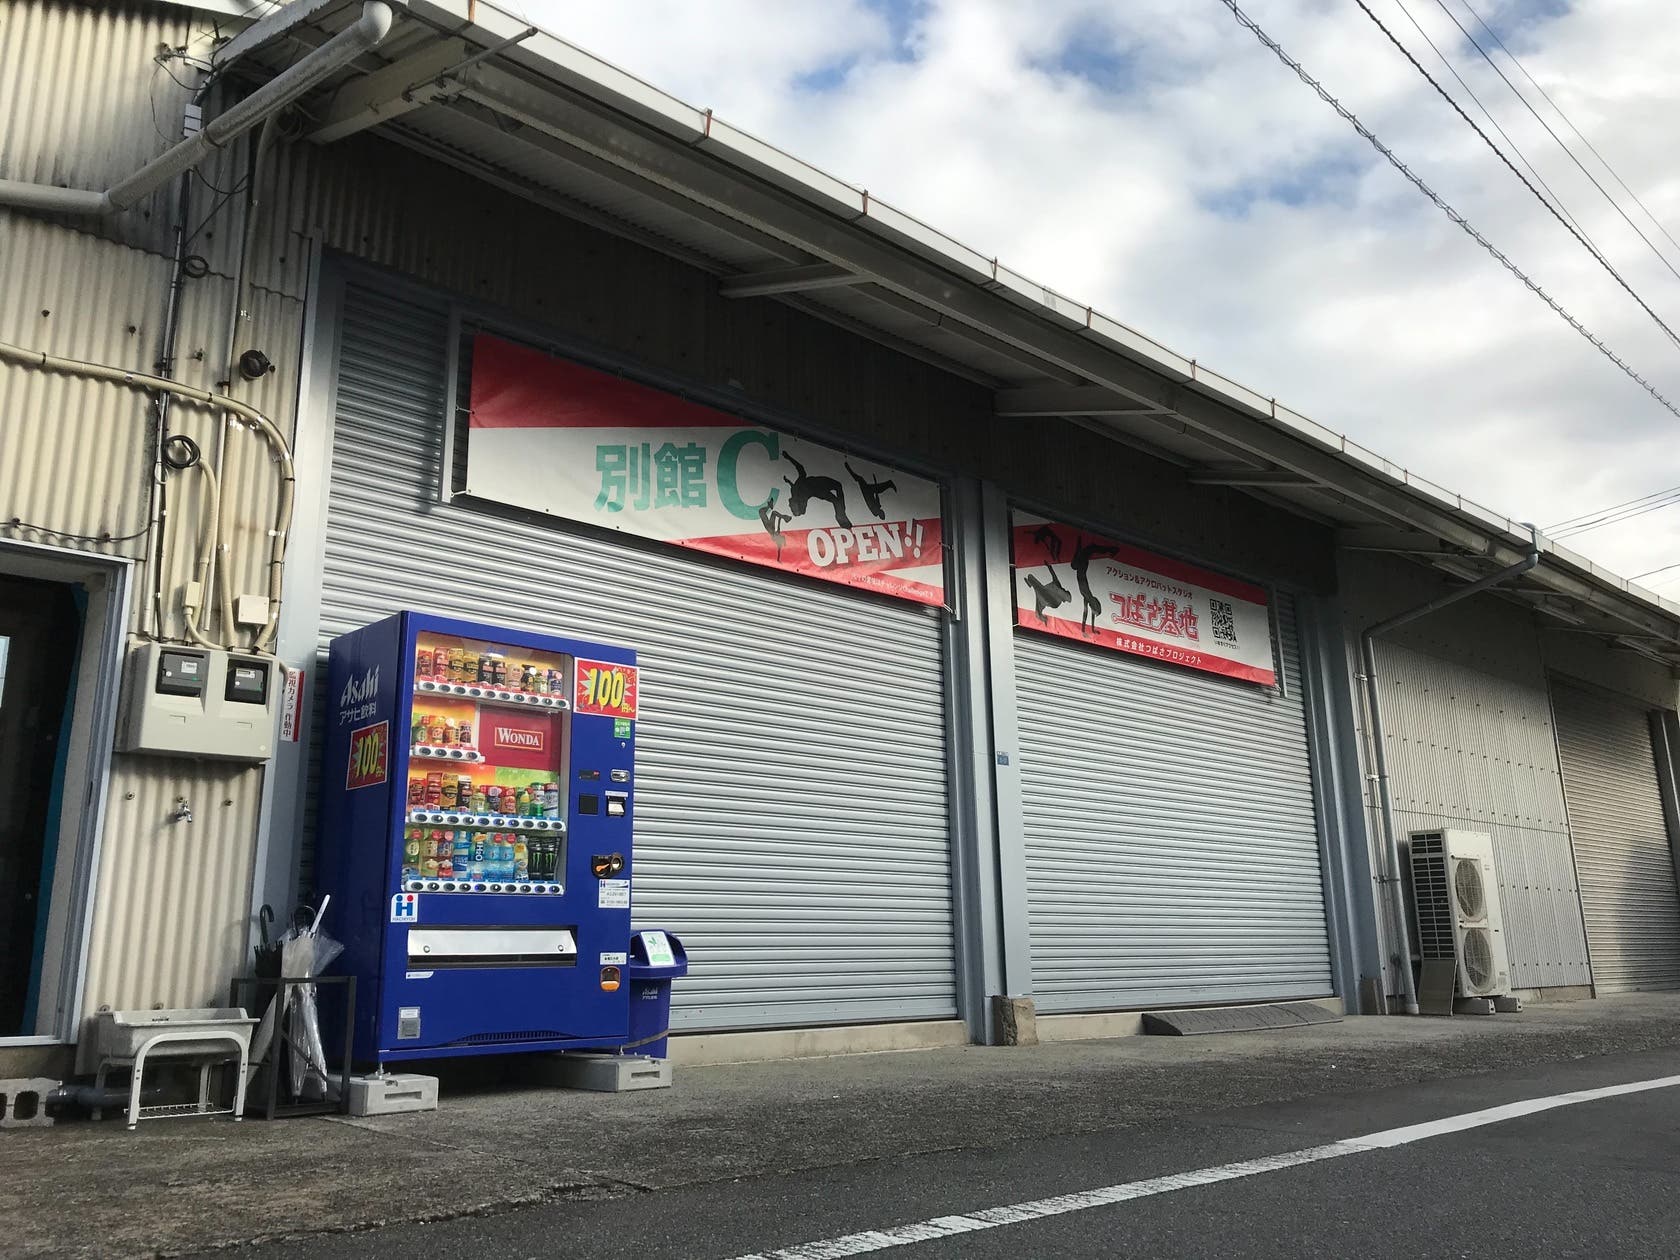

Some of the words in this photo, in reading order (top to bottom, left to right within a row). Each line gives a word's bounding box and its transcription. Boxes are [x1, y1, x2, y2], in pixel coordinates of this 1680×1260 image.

[807, 518, 924, 568] OPEN!!
[1109, 593, 1200, 642] つばさ基地
[1116, 638, 1201, 664] 株式会社つばさプロジェクト
[340, 664, 379, 707] Asahi
[339, 702, 376, 725] アサヒ飲料
[498, 728, 539, 746] WONDA
